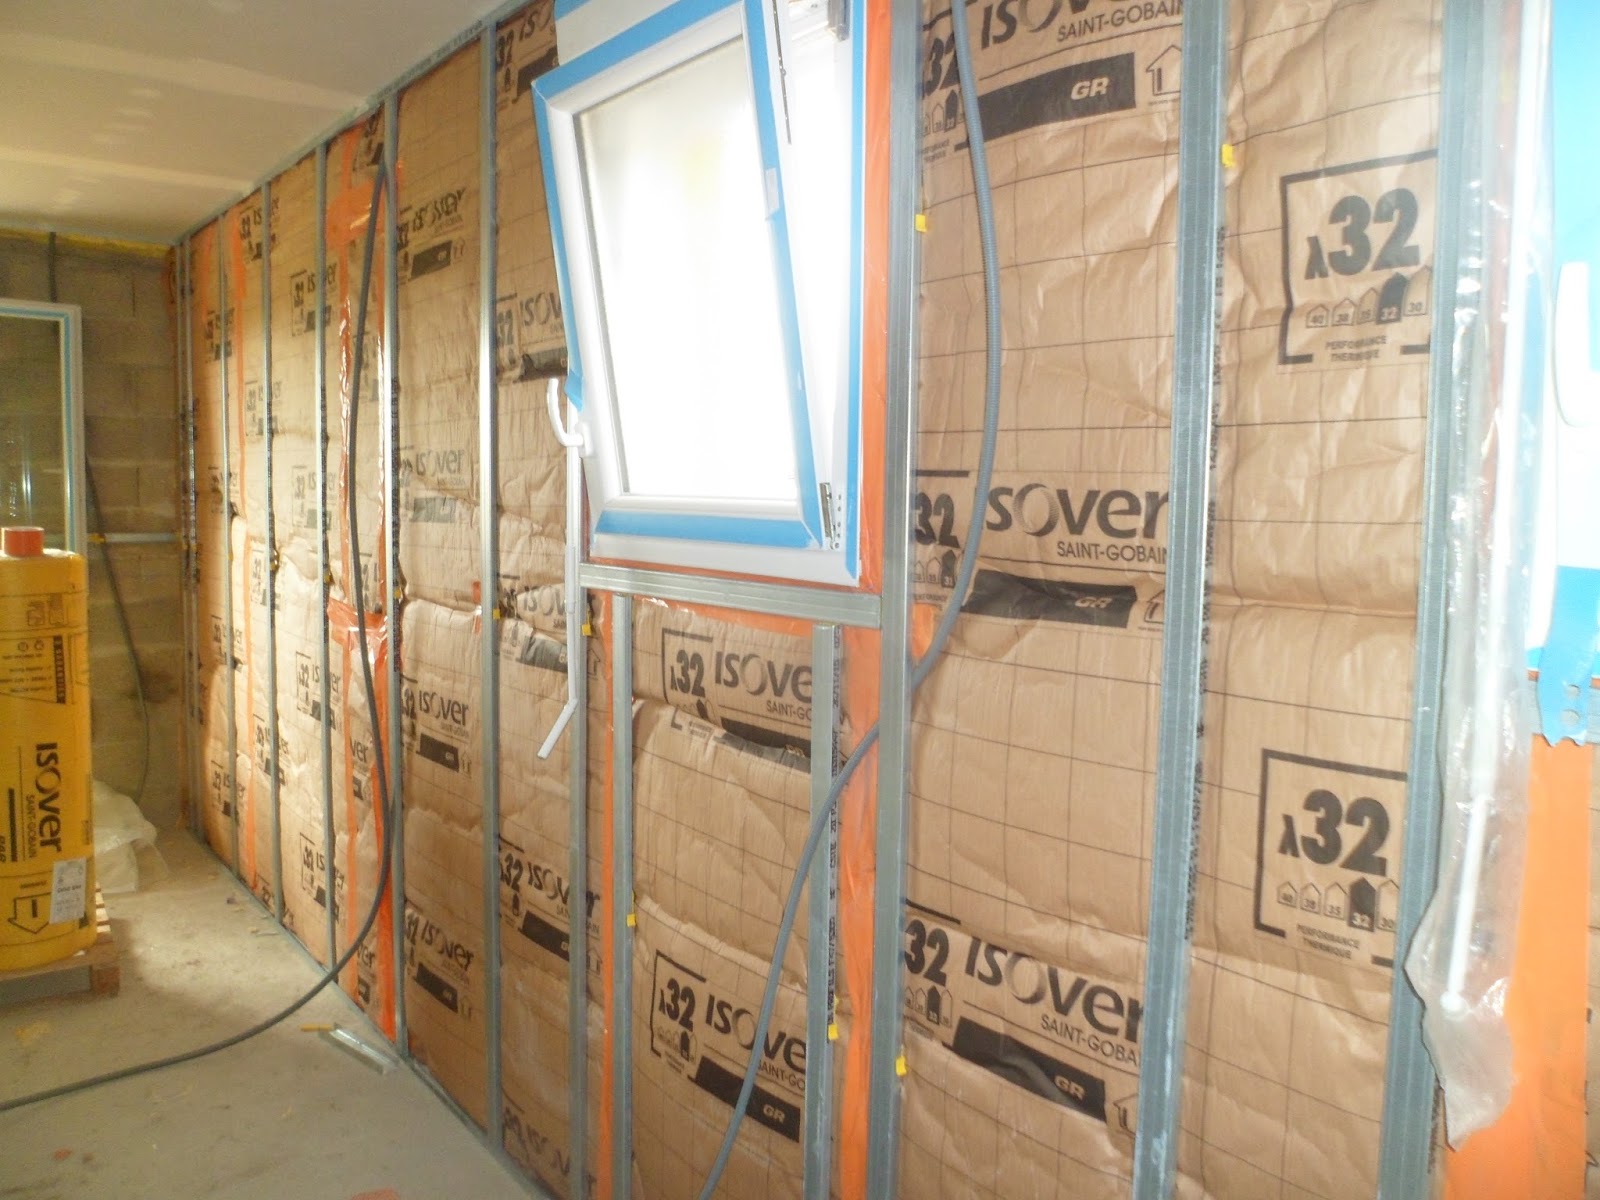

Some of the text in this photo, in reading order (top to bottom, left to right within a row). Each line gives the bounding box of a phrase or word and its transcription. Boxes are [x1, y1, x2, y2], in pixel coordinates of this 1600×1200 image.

[1071, 77, 1109, 100] GR
[914, 492, 960, 549] 32
[766, 700, 812, 721] SAINT-GO
[905, 919, 950, 987] 32
[1041, 1014, 1138, 1067] SAINT-GOBA
[1054, 1075, 1086, 1100] GR
[763, 1103, 786, 1124] GR
